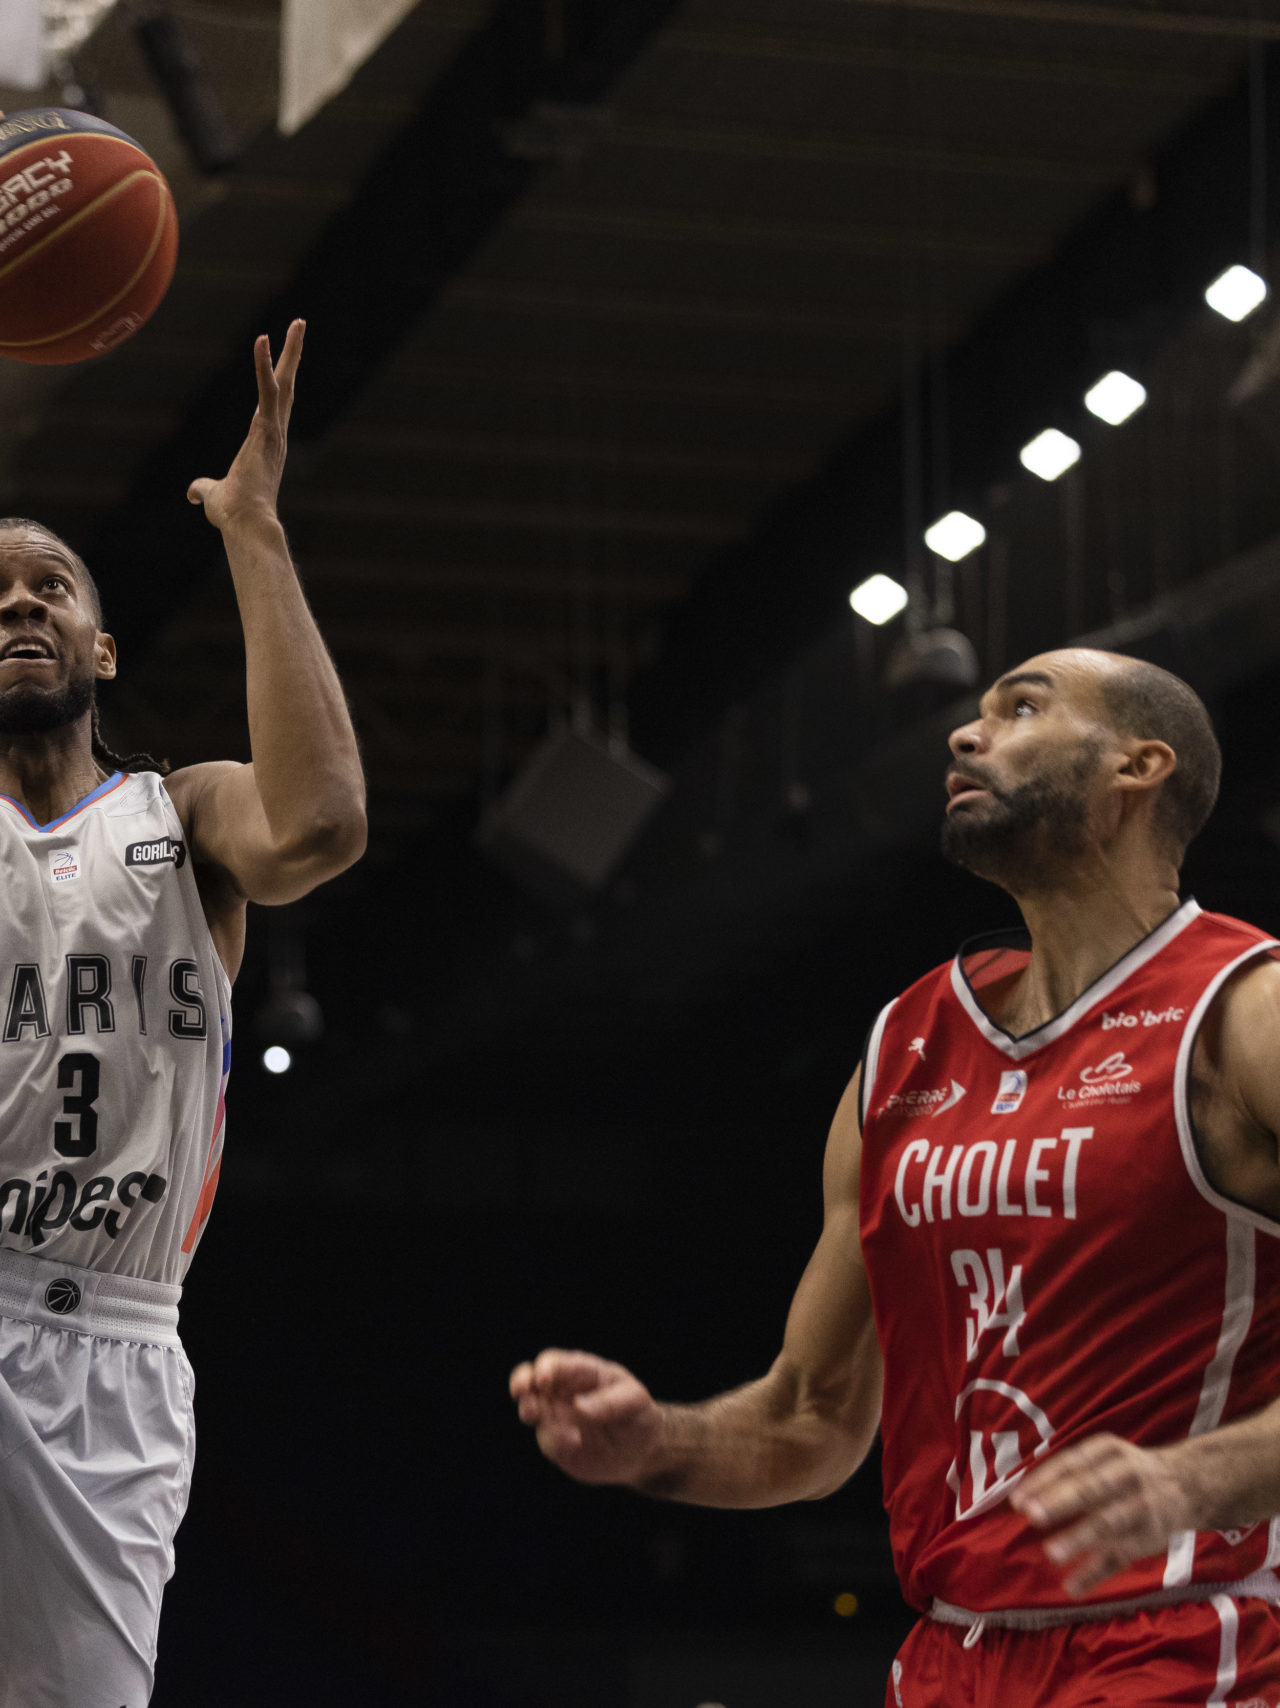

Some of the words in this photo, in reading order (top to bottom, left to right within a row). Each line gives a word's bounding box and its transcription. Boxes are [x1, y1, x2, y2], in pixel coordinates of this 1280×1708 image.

[54, 1053, 100, 1157] 3
[1057, 1086, 1076, 1100] Le
[1078, 1080, 1141, 1099] Choletais
[895, 1127, 1094, 1228] CHOLET
[950, 1248, 1026, 1362] 34
